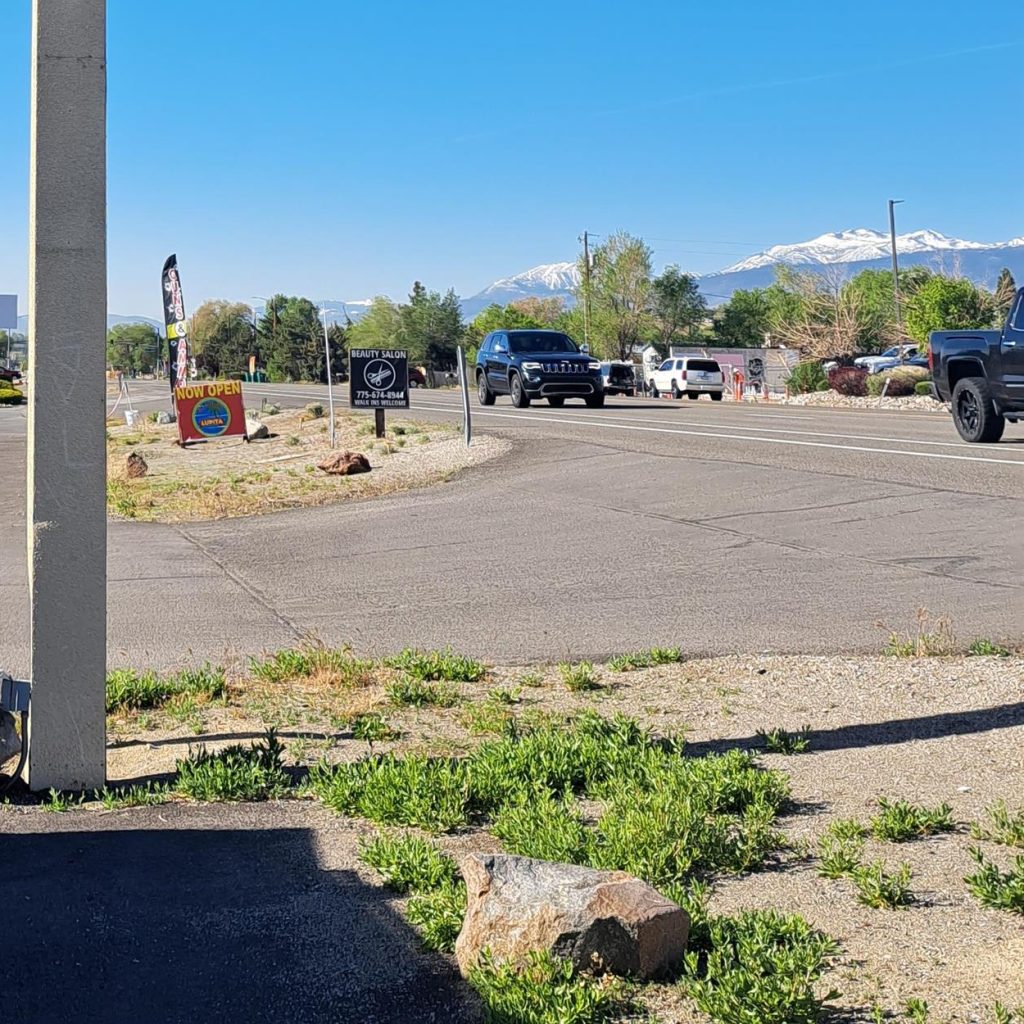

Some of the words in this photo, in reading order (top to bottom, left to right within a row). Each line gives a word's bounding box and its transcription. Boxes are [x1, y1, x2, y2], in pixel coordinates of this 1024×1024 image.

[168, 268, 184, 320] GUNS
[351, 349, 379, 358] BEAUTY
[381, 350, 407, 358] SALON
[176, 385, 204, 400] NOW
[207, 381, 241, 396] OPEN
